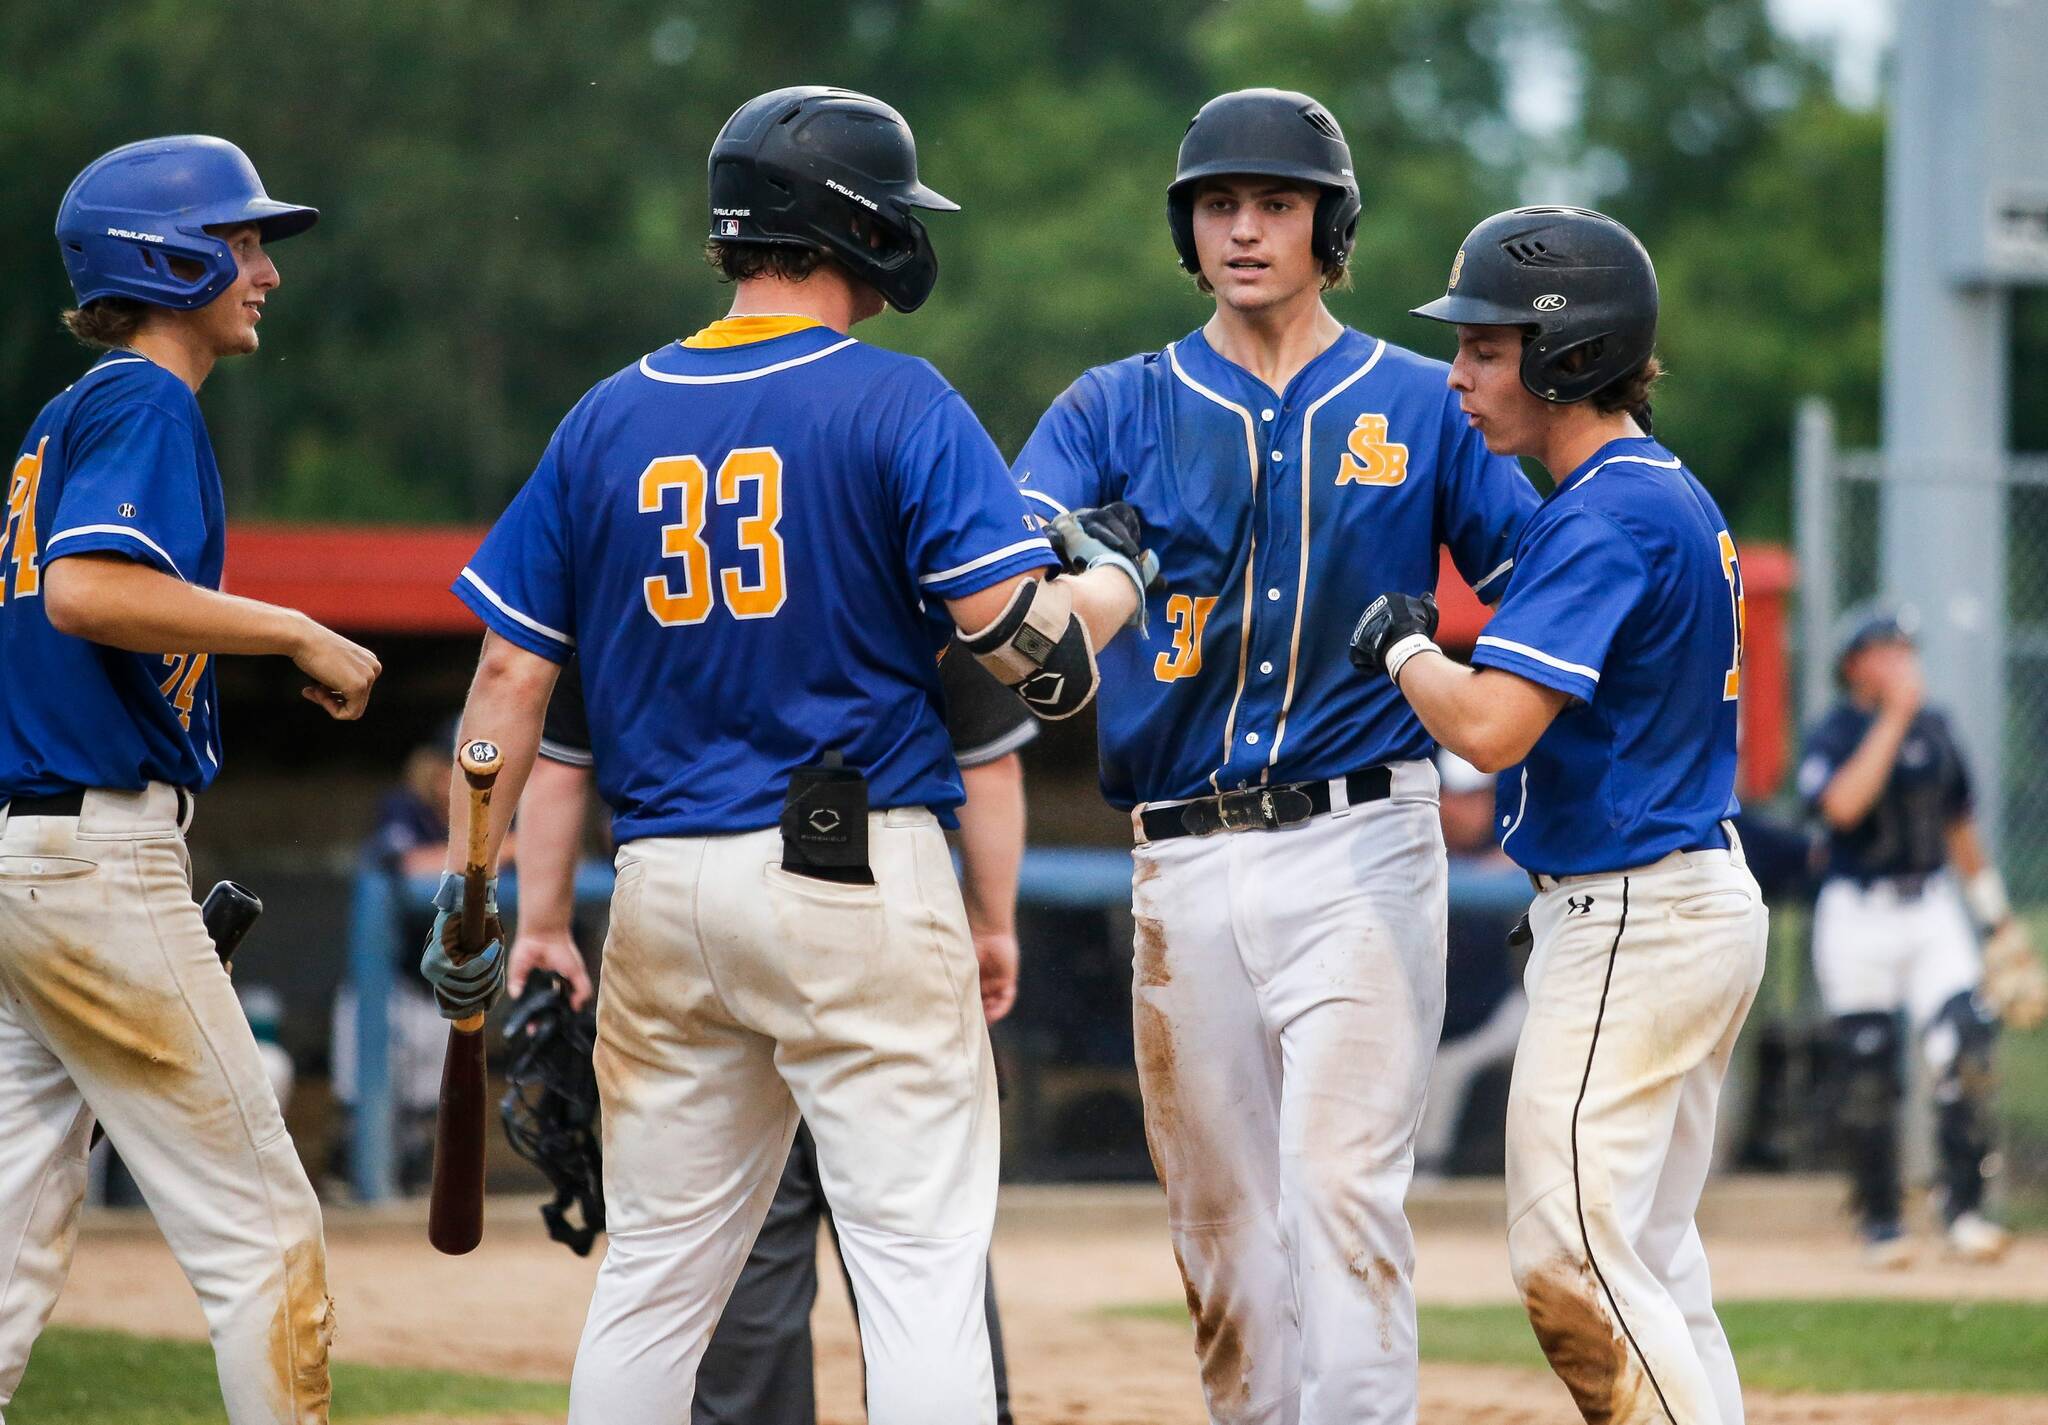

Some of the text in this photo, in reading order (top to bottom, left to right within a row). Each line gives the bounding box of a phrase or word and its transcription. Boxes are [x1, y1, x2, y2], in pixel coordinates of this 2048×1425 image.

[712, 207, 750, 217] RAWLINGS
[825, 179, 879, 212] RAWLINGS
[638, 446, 788, 628] 33
